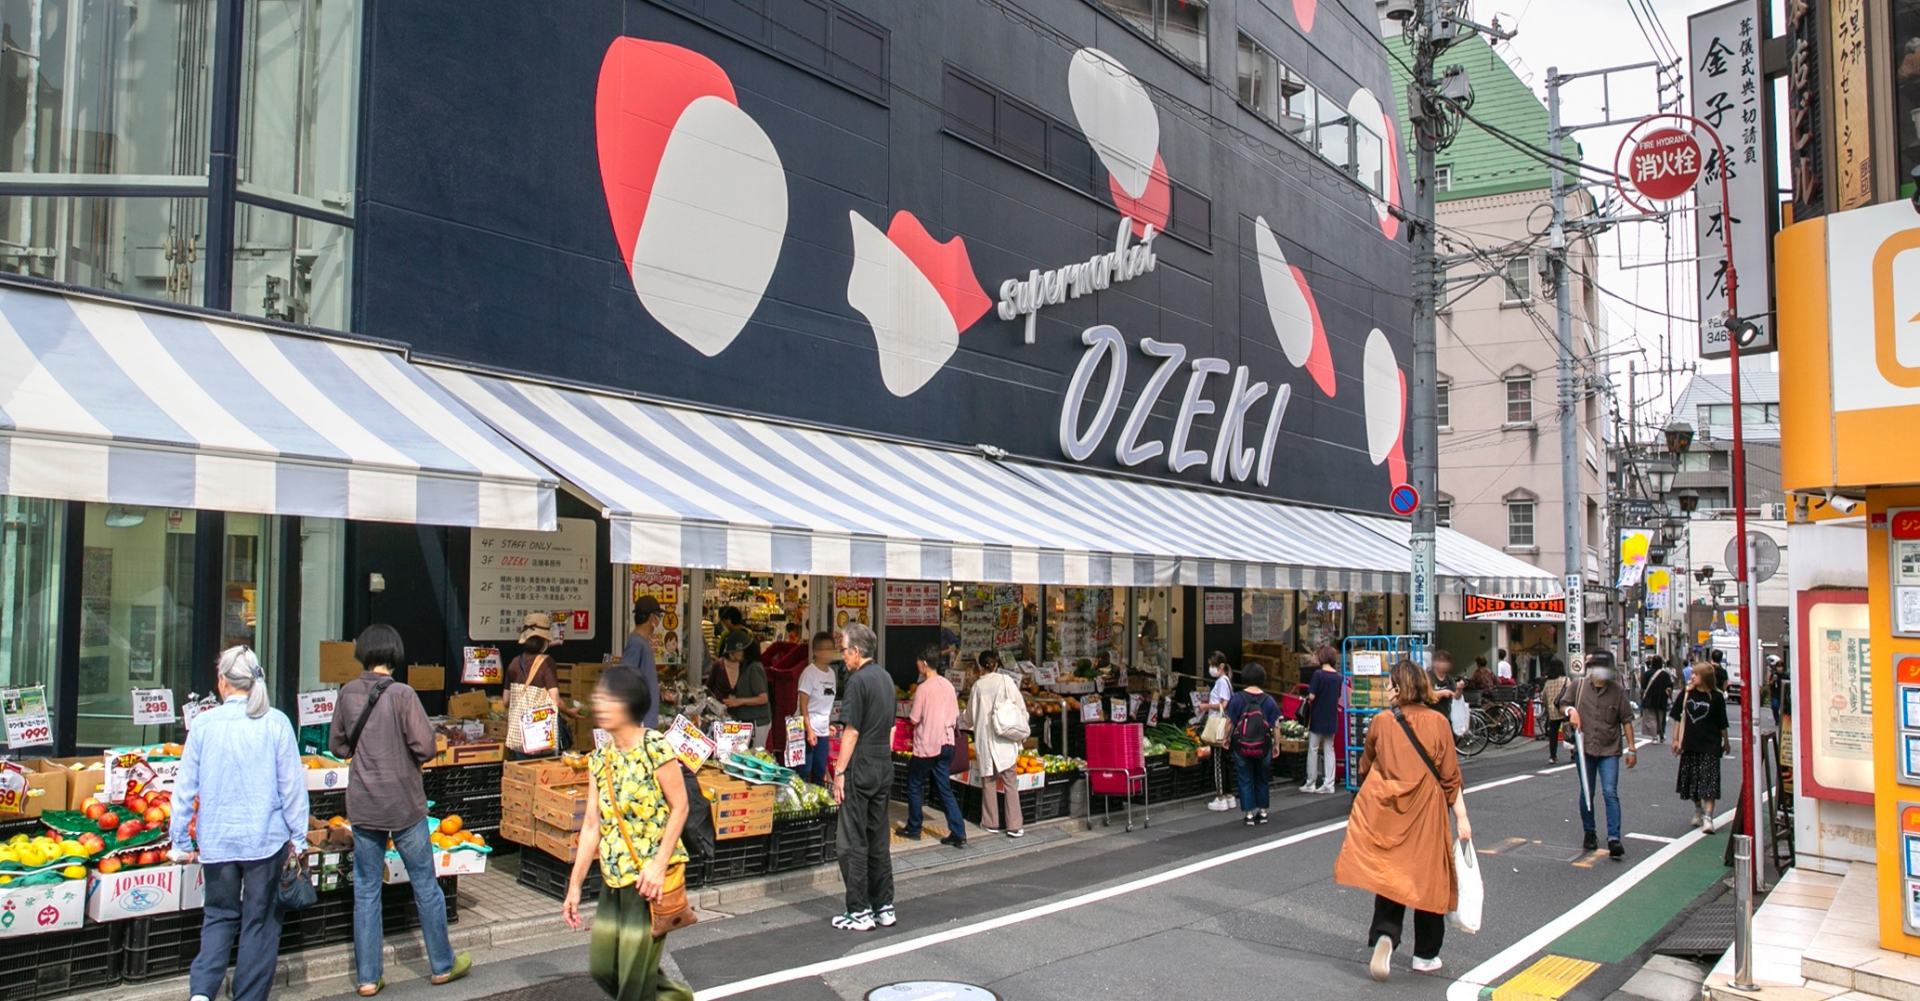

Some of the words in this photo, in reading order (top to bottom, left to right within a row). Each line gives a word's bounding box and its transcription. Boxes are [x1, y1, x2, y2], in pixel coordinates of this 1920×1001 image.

[1738, 17, 1757, 164] 葬儀式典一切請負
[1640, 140, 1655, 150] FIRE
[1656, 134, 1688, 147] HYDRANT
[1635, 145, 1697, 182] 消火栓
[997, 216, 1158, 344] supermarket
[1059, 325, 1291, 487] OZEKI
[482, 539, 494, 547] 4F
[502, 539, 528, 549] STAFF
[529, 541, 552, 551] ONLY
[481, 555, 494, 566] 3F
[500, 555, 528, 566] OZEKI
[480, 582, 493, 592] 2F
[1467, 595, 1505, 614] USED
[1510, 600, 1563, 611] CLOTHI
[480, 615, 491, 625] 1F
[479, 667, 498, 678] 599
[145, 702, 168, 713] 299
[314, 702, 333, 713] 299
[678, 742, 700, 763] 599
[112, 871, 173, 901] AOMORI
